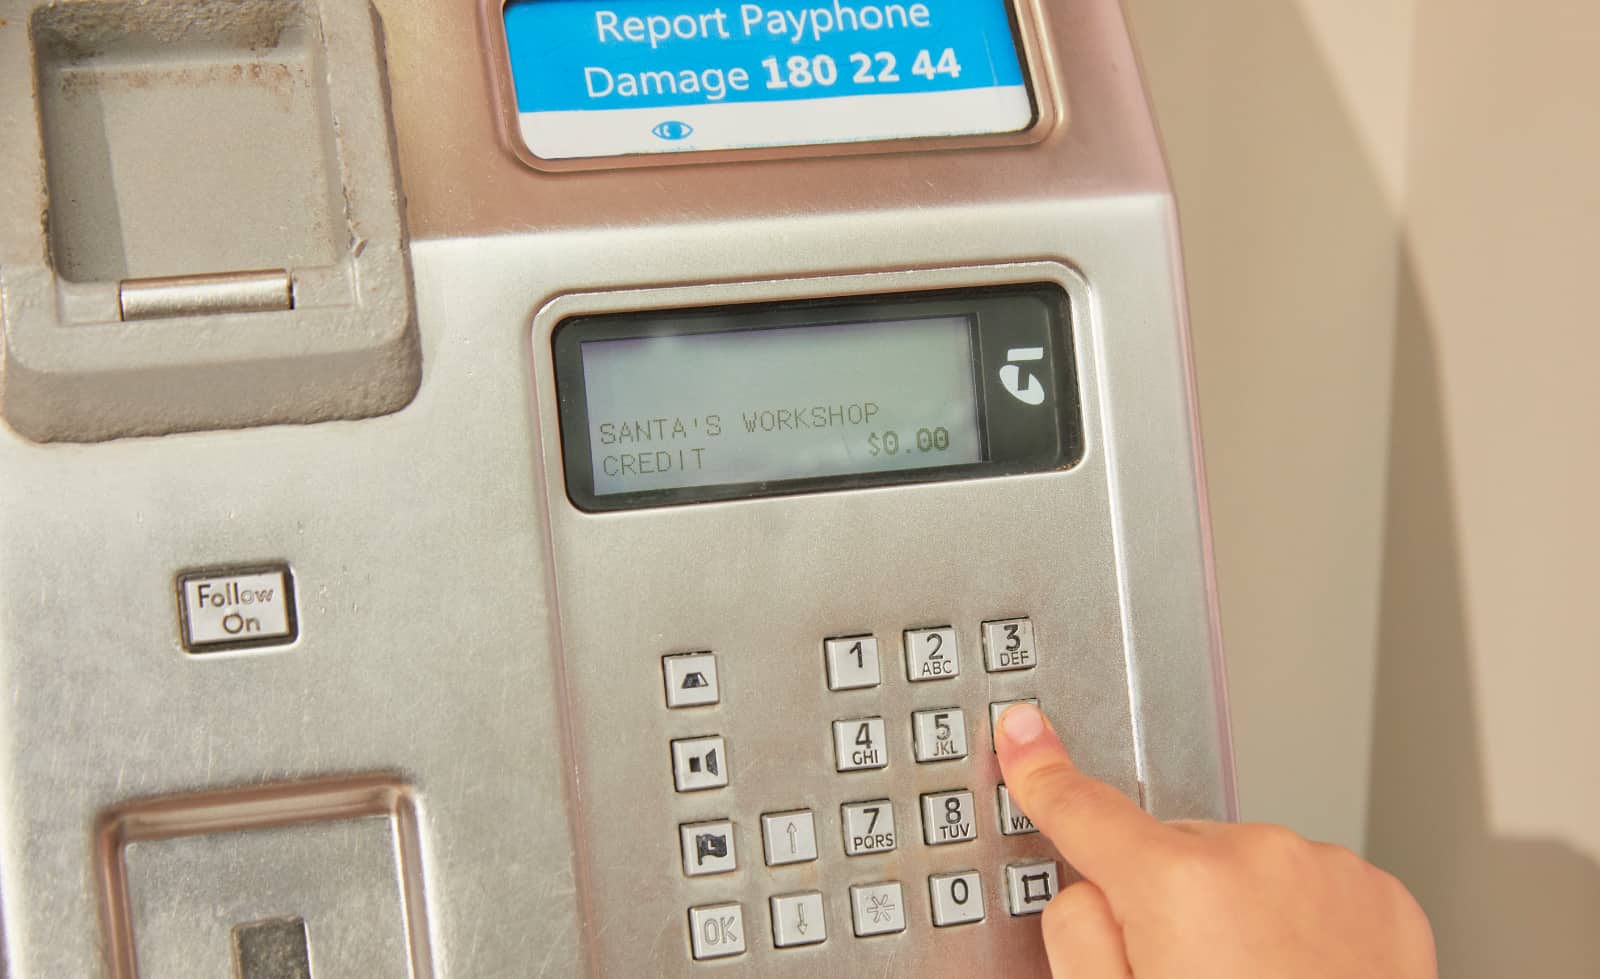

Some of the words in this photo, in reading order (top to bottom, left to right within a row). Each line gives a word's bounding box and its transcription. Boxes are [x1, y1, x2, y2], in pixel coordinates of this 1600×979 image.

[595, 8, 730, 49] Report
[740, 0, 930, 43] Payphone
[583, 66, 750, 100] Damage
[761, 54, 838, 89] 180
[849, 51, 900, 84] 22
[911, 47, 962, 80] 44
[600, 415, 721, 444] SANTA'S
[742, 402, 880, 433] WORKSHOP
[603, 448, 706, 477] CREDIT
[867, 426, 951, 457] $0.00
[197, 582, 274, 608] Follow
[222, 612, 261, 635] On
[927, 633, 944, 659] 2
[1005, 624, 1021, 651] 3
[849, 642, 863, 668] 1
[1001, 650, 1030, 667] DEF
[922, 661, 954, 676] ABC
[855, 722, 872, 748] 4
[935, 714, 951, 740] 5
[852, 750, 879, 766] GHI
[933, 741, 958, 757] JKL
[863, 808, 881, 834] 7
[945, 797, 962, 824] 8
[854, 834, 894, 850] PQRS
[940, 823, 970, 840] TUV
[703, 915, 737, 946] OK
